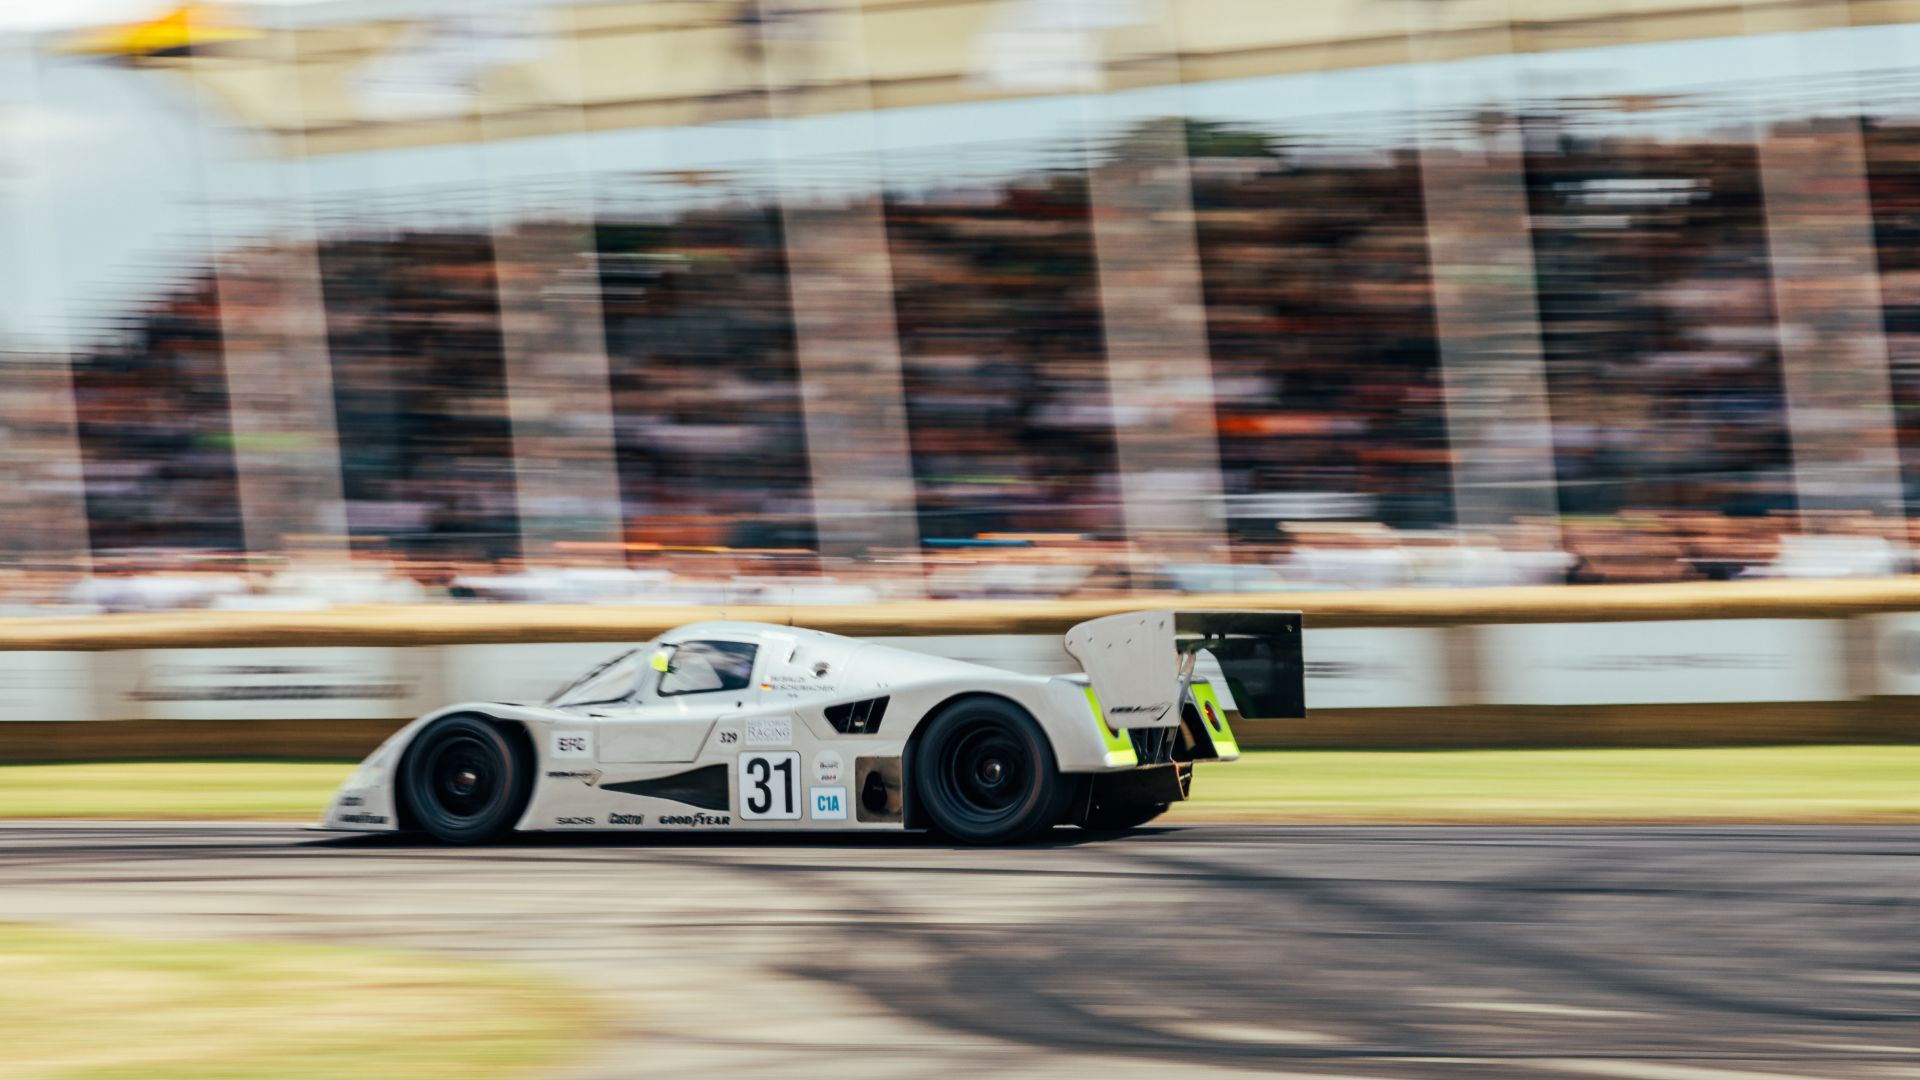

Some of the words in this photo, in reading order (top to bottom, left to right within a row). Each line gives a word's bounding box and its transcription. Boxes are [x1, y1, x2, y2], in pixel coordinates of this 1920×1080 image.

[720, 732, 737, 743] 329
[748, 727, 790, 737] RACING
[747, 757, 793, 814] 31
[817, 796, 840, 811] C1A
[556, 816, 596, 825] SACHS
[608, 813, 644, 825] Castrol
[659, 812, 731, 827] GOODYEAR
